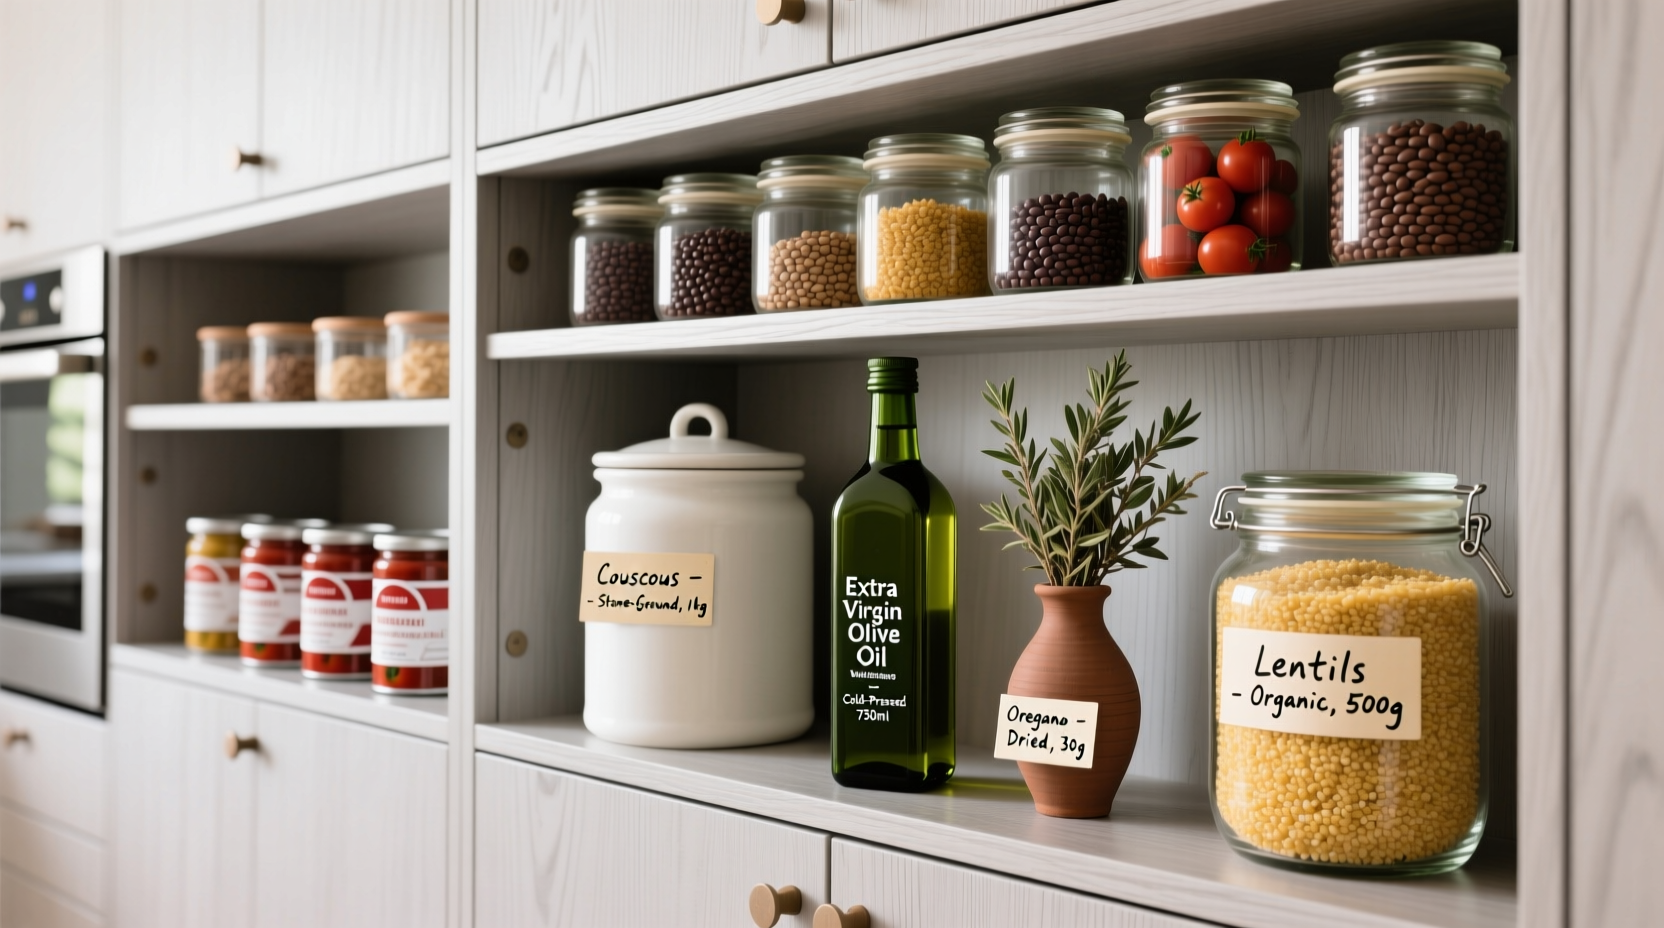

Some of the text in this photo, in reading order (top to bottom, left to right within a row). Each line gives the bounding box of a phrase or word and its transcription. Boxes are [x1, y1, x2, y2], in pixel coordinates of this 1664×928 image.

[597, 562, 680, 588] Couscous
[845, 575, 898, 598] Extra
[687, 595, 708, 619] 1kg
[842, 599, 903, 626] Virgin
[847, 622, 901, 644] Olive
[856, 644, 887, 668] Oil
[1254, 644, 1366, 684] Lentils
[1006, 704, 1069, 732] Oregano
[1250, 684, 1336, 718] Organic,
[1345, 692, 1404, 731] 500g
[1007, 728, 1086, 761] Dried, 30g
